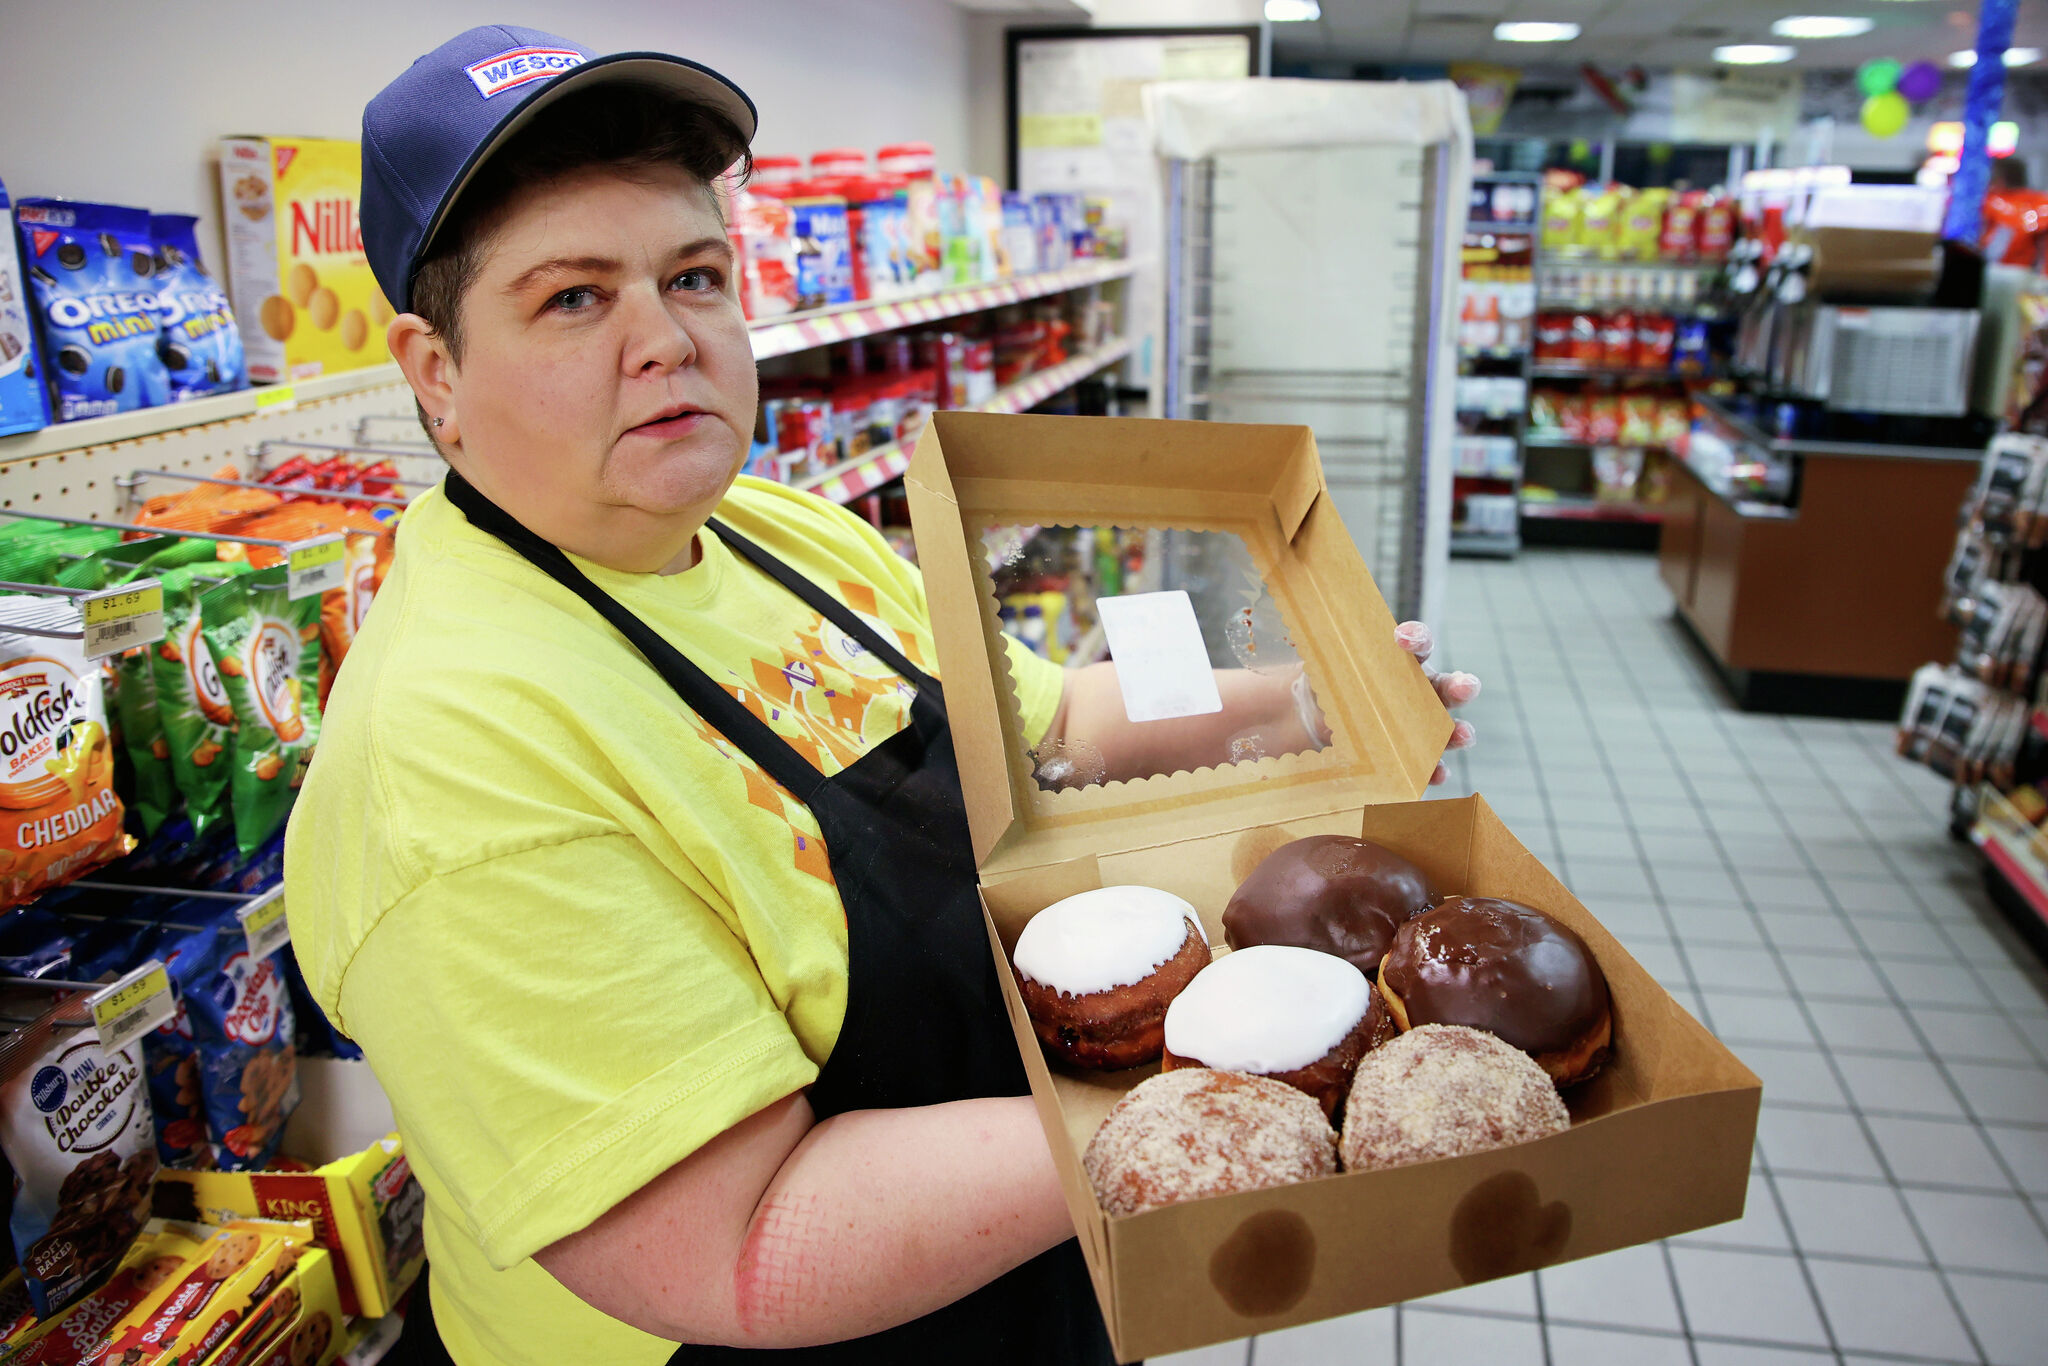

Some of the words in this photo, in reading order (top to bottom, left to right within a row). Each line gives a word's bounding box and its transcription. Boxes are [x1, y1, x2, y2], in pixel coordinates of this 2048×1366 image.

[483, 55, 581, 84] WESCO
[50, 292, 160, 327] OREO
[88, 311, 155, 345] mini
[103, 592, 140, 610] $1.69
[0, 681, 86, 757] oldfish
[9, 736, 51, 769] BAKED
[17, 787, 117, 849] CHEDDAR
[70, 1057, 96, 1086] MINI
[33, 1072, 65, 1107] Pillsbury
[56, 1062, 120, 1126] Double
[57, 1067, 140, 1153] Chocolate
[265, 1198, 323, 1217] KING
[34, 1238, 61, 1265] SOFT
[37, 1241, 73, 1277] BAKED
[61, 1296, 105, 1337] Soft
[72, 1299, 129, 1355] Batch
[141, 1316, 176, 1344] Soft
[164, 1281, 204, 1316] Batch
